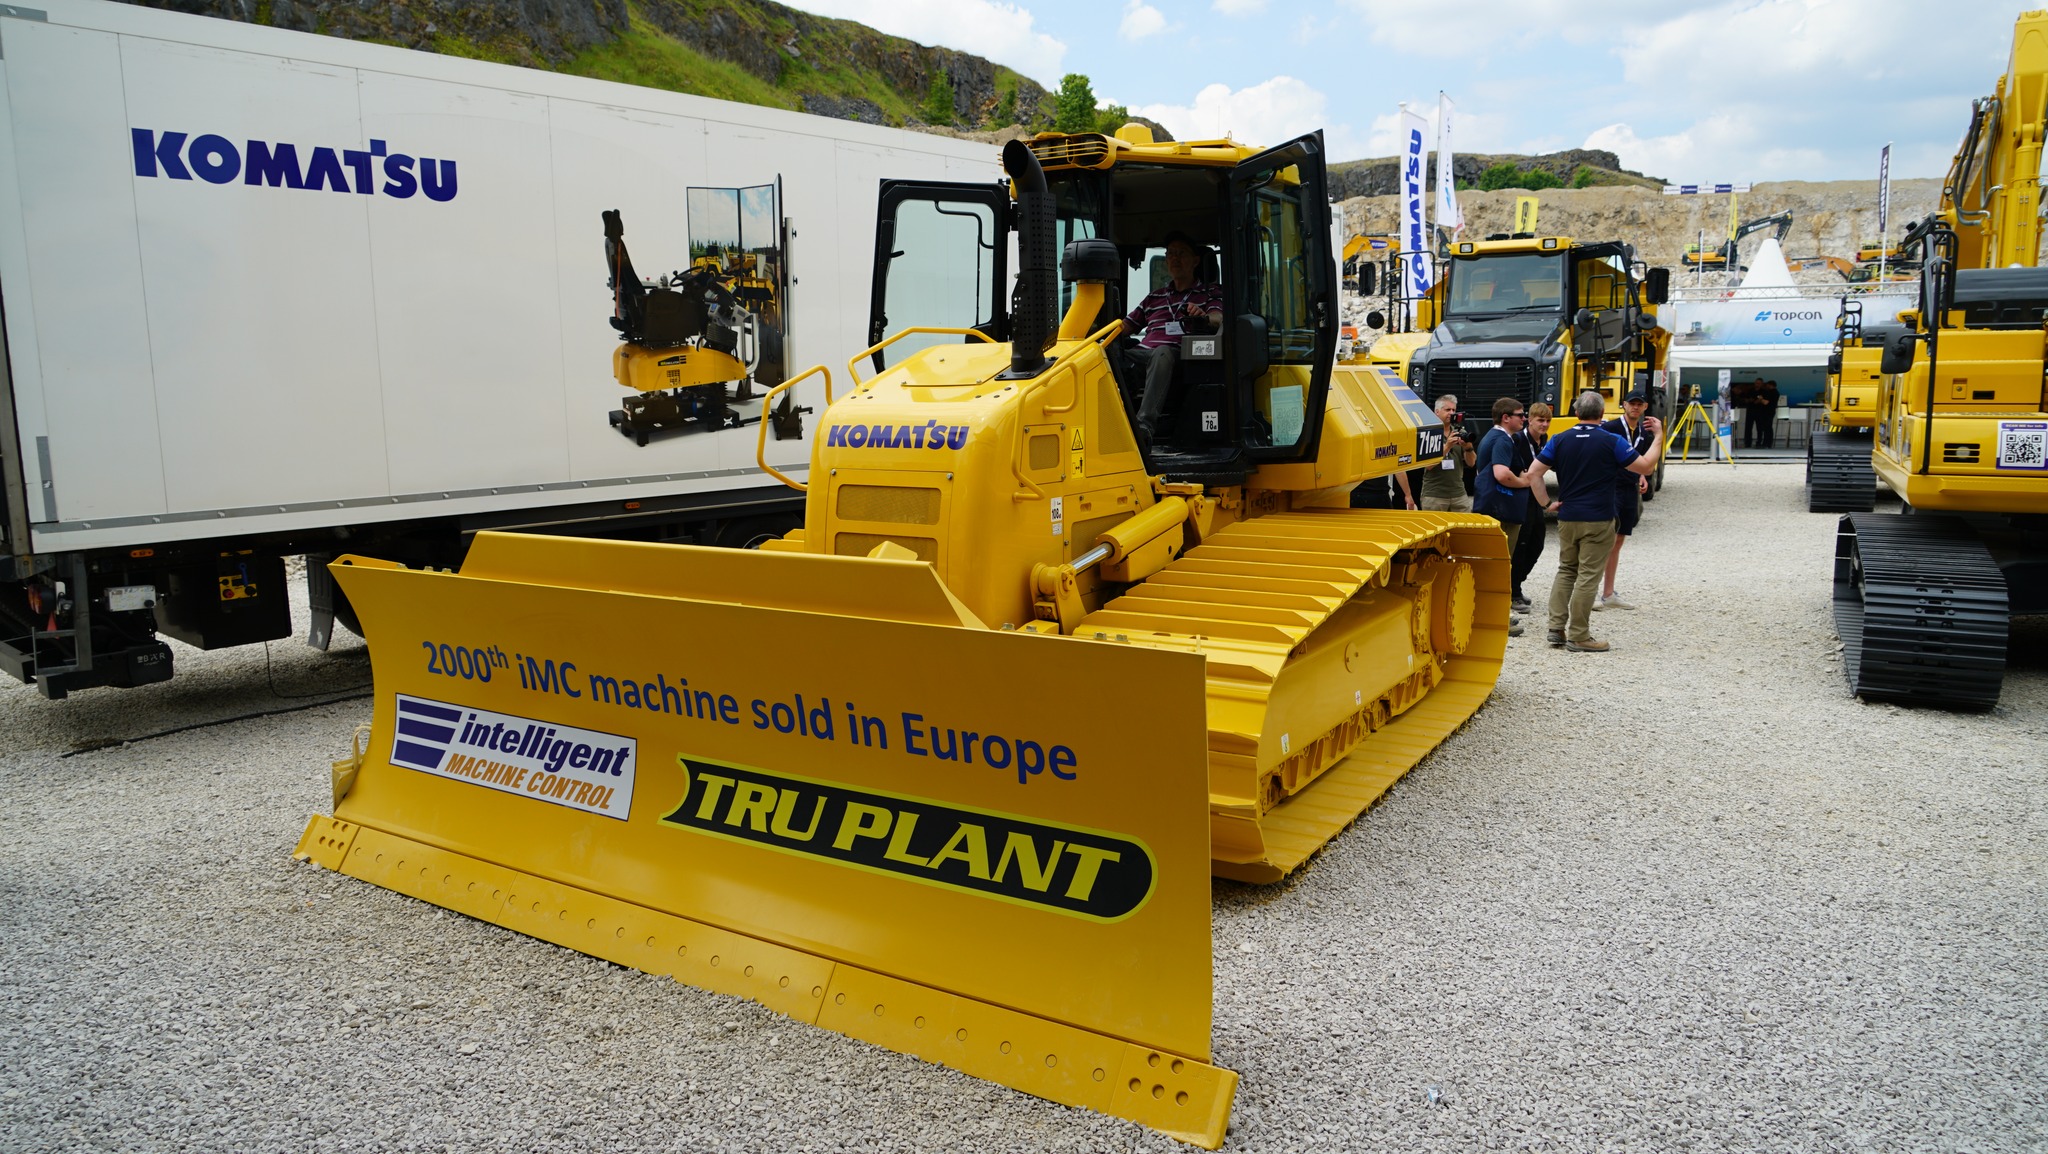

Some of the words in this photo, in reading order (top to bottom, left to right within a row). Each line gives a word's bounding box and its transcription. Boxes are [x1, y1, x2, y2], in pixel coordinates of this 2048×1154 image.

[131, 128, 458, 202] KOMATSU
[1406, 129, 1431, 297] KOMATSU
[1773, 311, 1823, 321] TOPCON
[1459, 360, 1502, 369] KOMATSU
[827, 419, 970, 450] KOMATSU
[1374, 442, 1398, 459] KOMATSU
[422, 641, 509, 683] 2000th
[515, 653, 582, 697] iMC
[588, 673, 740, 724] machine
[752, 694, 835, 740] sold
[845, 702, 888, 750] in
[901, 712, 1077, 784] Europe
[458, 713, 630, 777] intelligent
[444, 753, 529, 789] MACHINE
[525, 774, 615, 810] CONTROL
[695, 772, 828, 841] TRU
[831, 800, 1121, 902] PLANT
